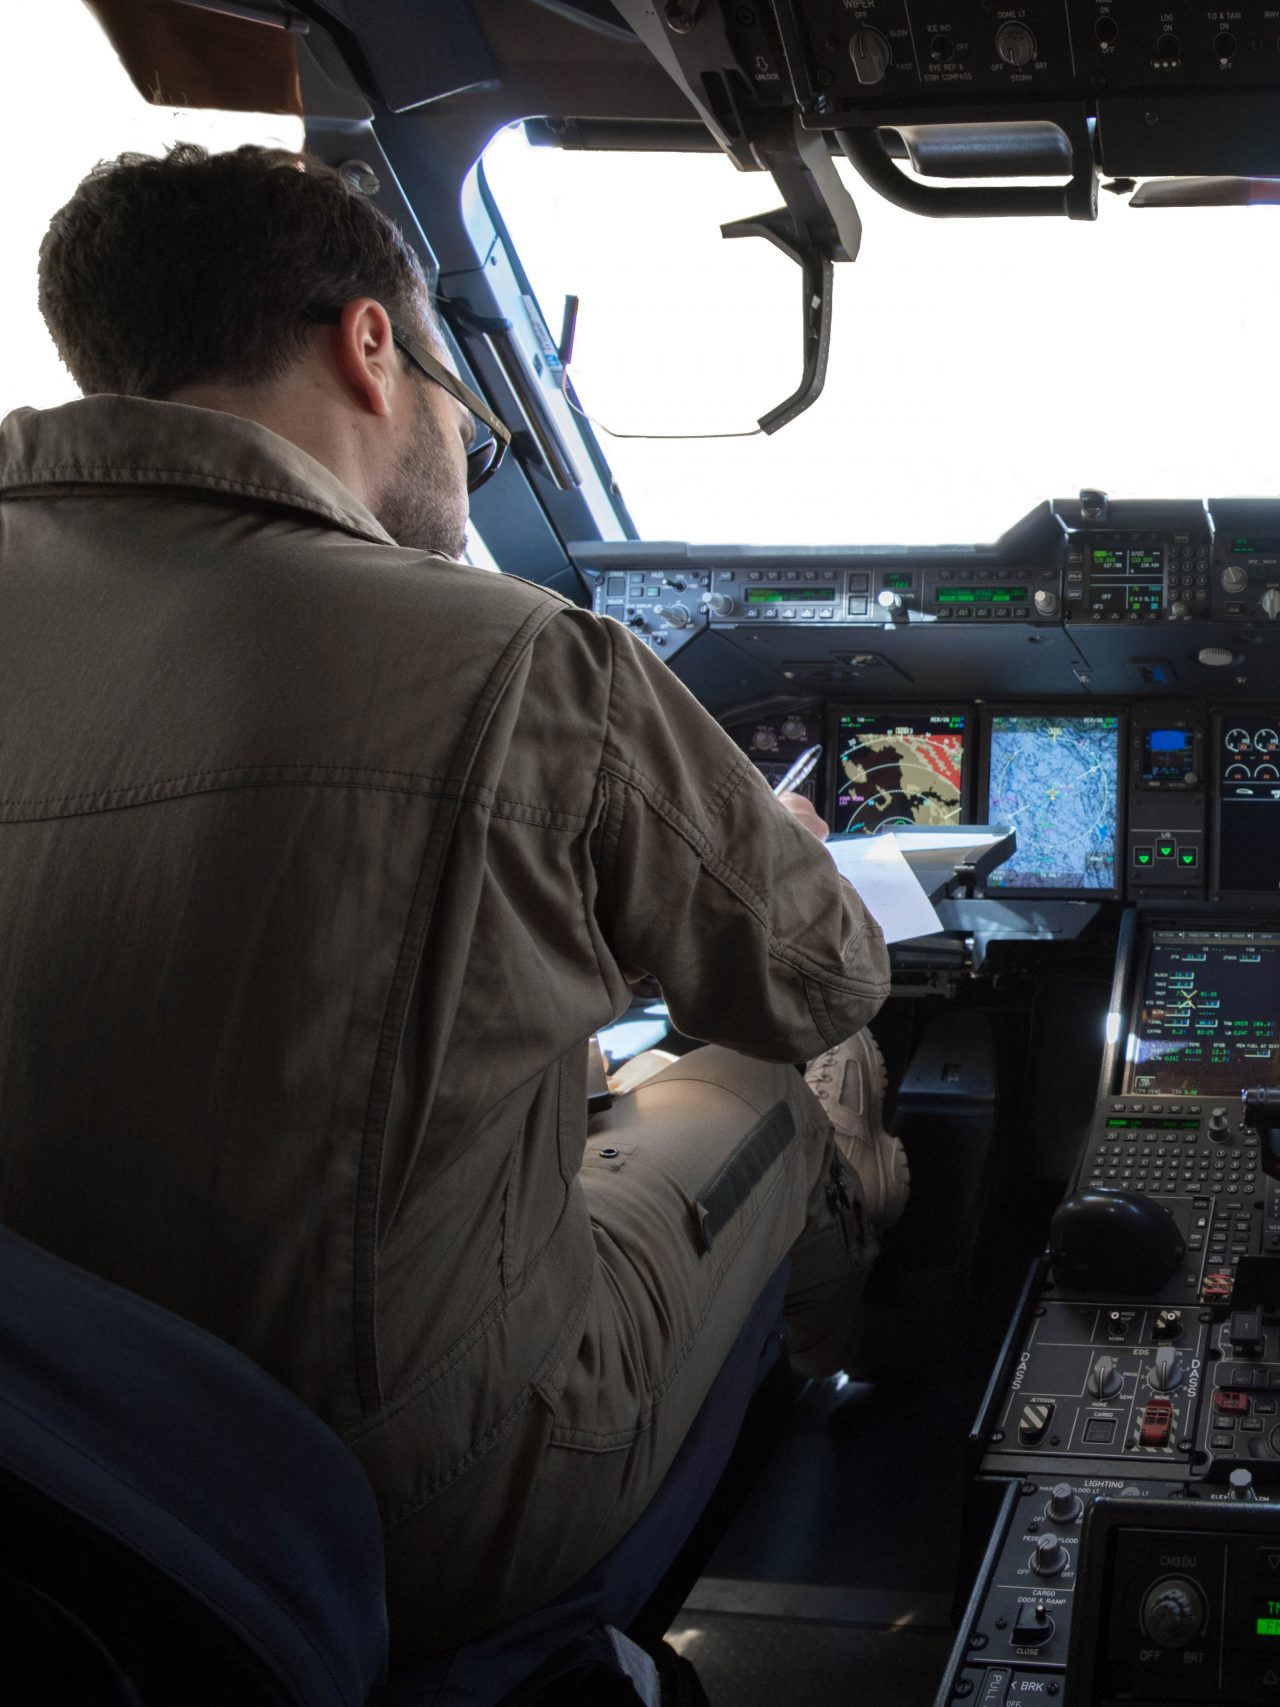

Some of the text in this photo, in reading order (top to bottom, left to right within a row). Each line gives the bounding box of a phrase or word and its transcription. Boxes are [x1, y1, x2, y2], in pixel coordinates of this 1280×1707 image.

[1219, 22, 1230, 31] ON
[1012, 1353, 1031, 1390] DASS
[1187, 1360, 1201, 1398] DASS
[1084, 1480, 1124, 1488] LIGHTING
[1016, 1648, 1040, 1656] CLOSE
[1140, 1649, 1163, 1662] OFF
[1183, 1652, 1204, 1664] BRT
[985, 1674, 1003, 1702] PULL
[1020, 1682, 1044, 1692] BRK
